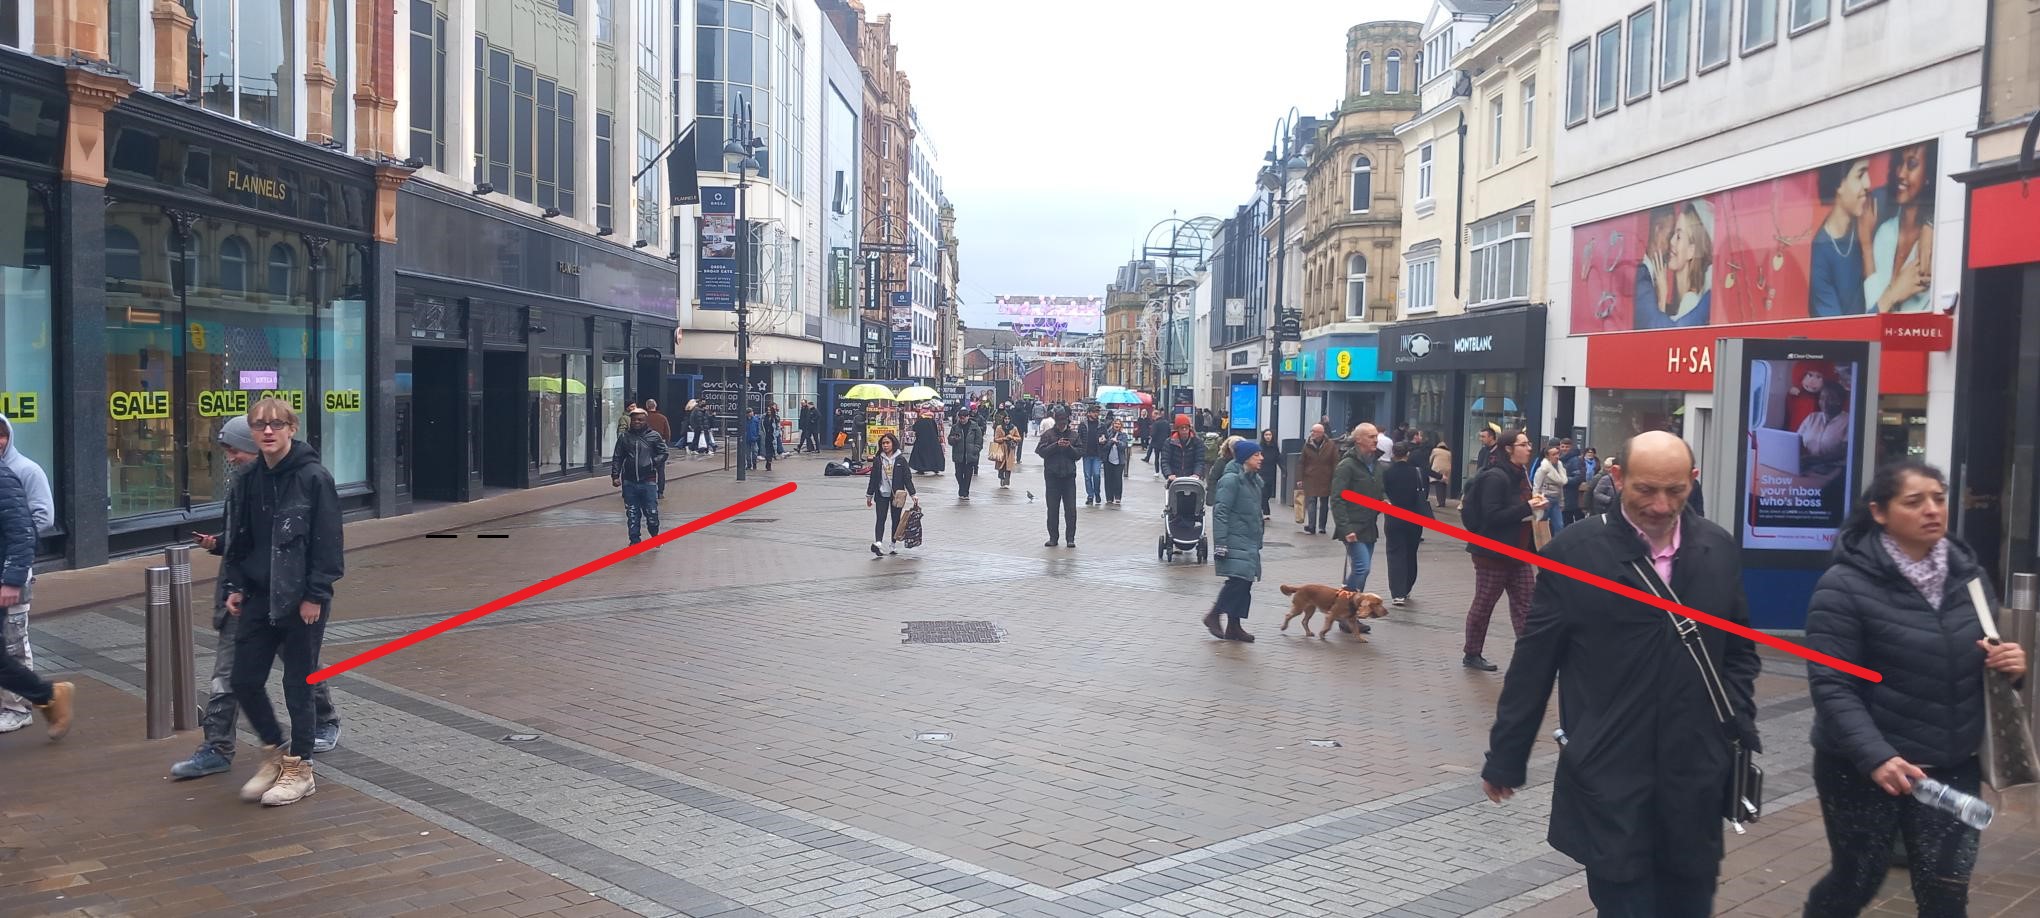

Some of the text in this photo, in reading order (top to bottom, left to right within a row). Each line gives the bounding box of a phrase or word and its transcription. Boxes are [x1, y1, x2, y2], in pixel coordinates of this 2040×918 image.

[228, 170, 286, 200] FLANNELS
[1454, 335, 1492, 353] MONTBLANC
[112, 395, 167, 416] SALE
[200, 394, 246, 413] SALE
[325, 392, 359, 409] SALE
[1760, 474, 1793, 485] Show
[1760, 486, 1822, 497] your inbox
[1759, 497, 1822, 507] who's boss
